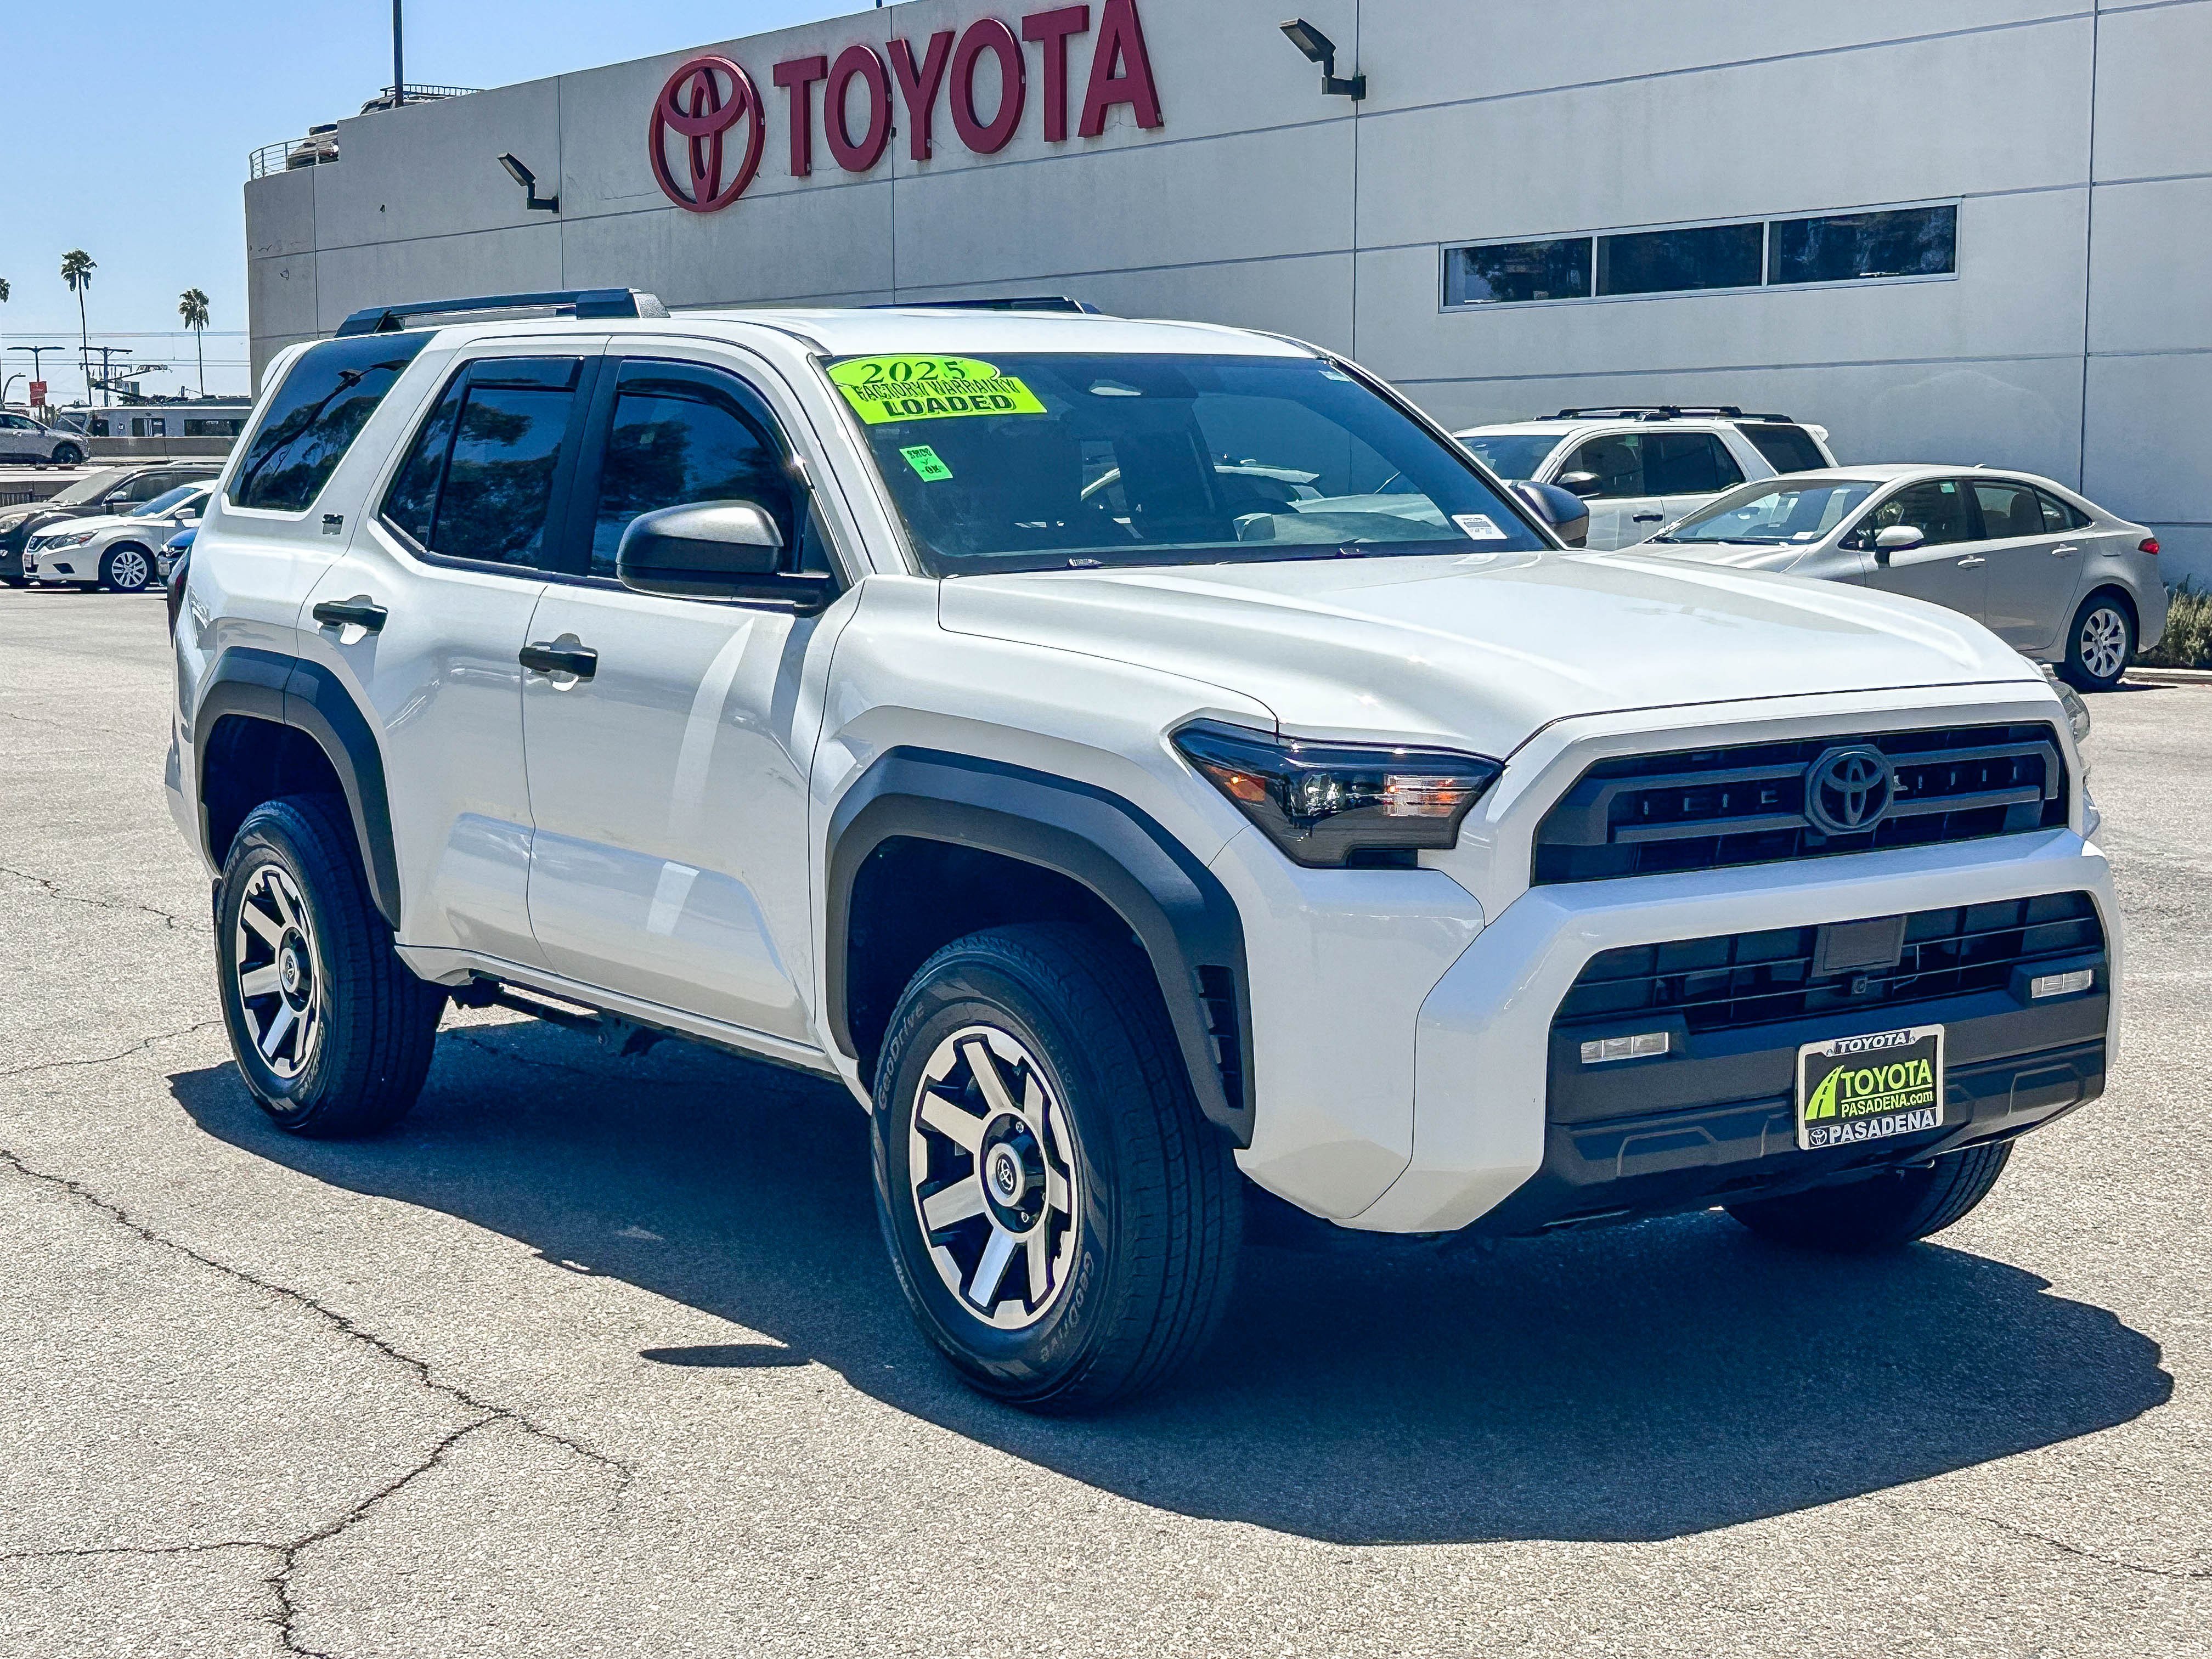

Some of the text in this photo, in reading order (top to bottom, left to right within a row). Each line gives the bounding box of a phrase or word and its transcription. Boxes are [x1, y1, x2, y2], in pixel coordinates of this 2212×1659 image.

[772, 0, 1165, 177] TOYOTA
[861, 362, 966, 384] 2025
[851, 378, 1020, 401] FACTORY WARRANTY
[882, 395, 1016, 416] LOADED
[1838, 1032, 1906, 1053] TOYOTA
[1841, 1059, 1932, 1097] TOYOTA
[1841, 1091, 1934, 1118] PASADENA.com
[1829, 1110, 1935, 1144] PASADENA
